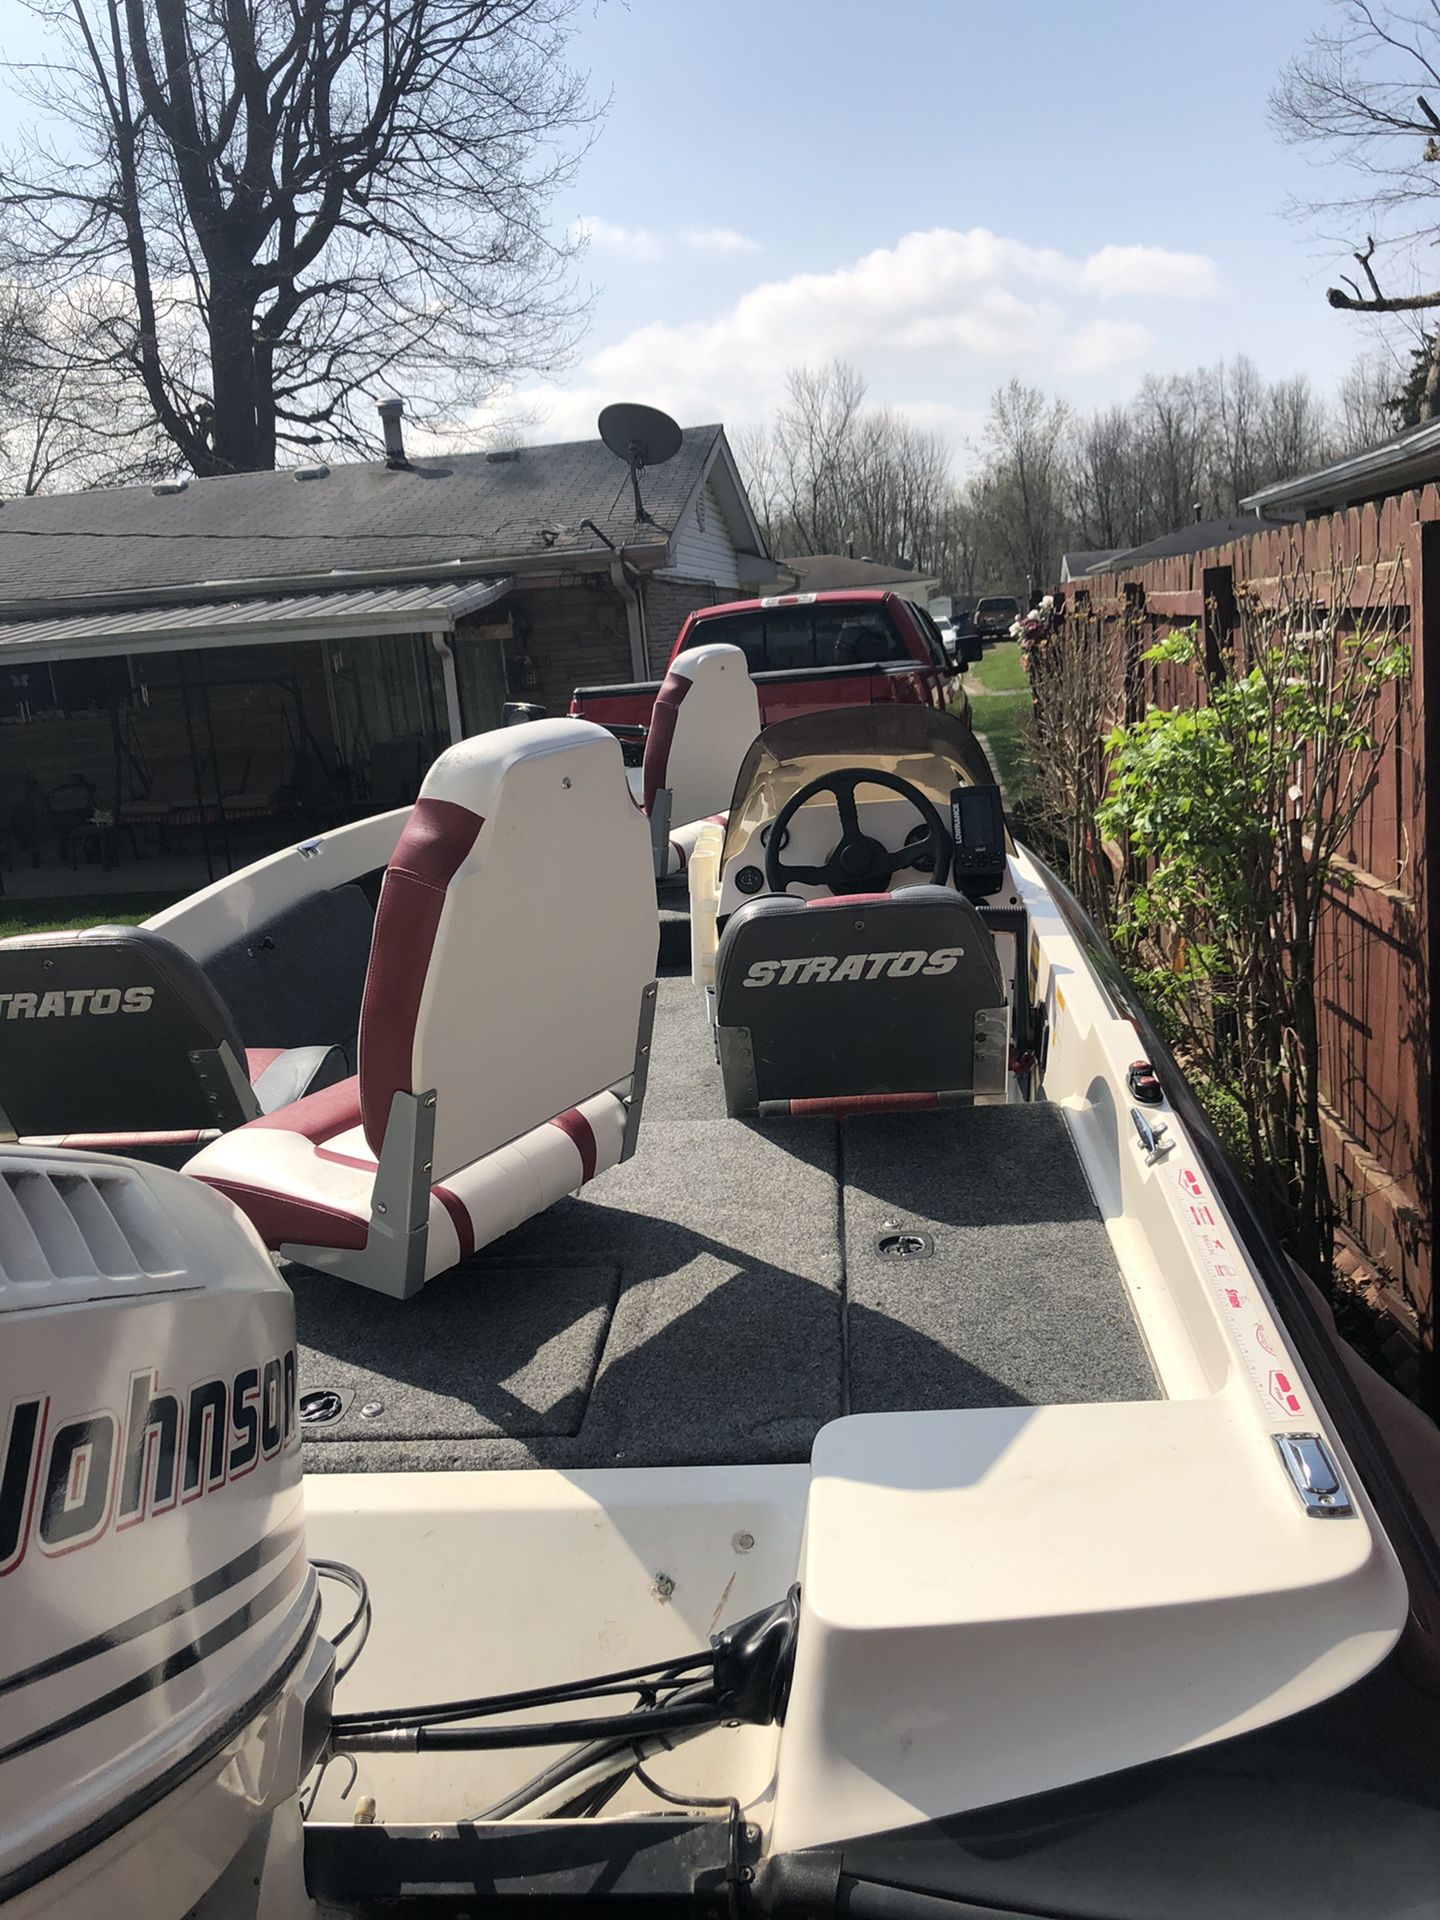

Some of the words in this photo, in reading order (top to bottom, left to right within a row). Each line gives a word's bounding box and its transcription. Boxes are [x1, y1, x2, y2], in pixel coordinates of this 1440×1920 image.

[952, 802, 962, 845] LOWRANCE
[742, 947, 965, 988] STRATOS
[0, 1349, 297, 1578] Johnson
